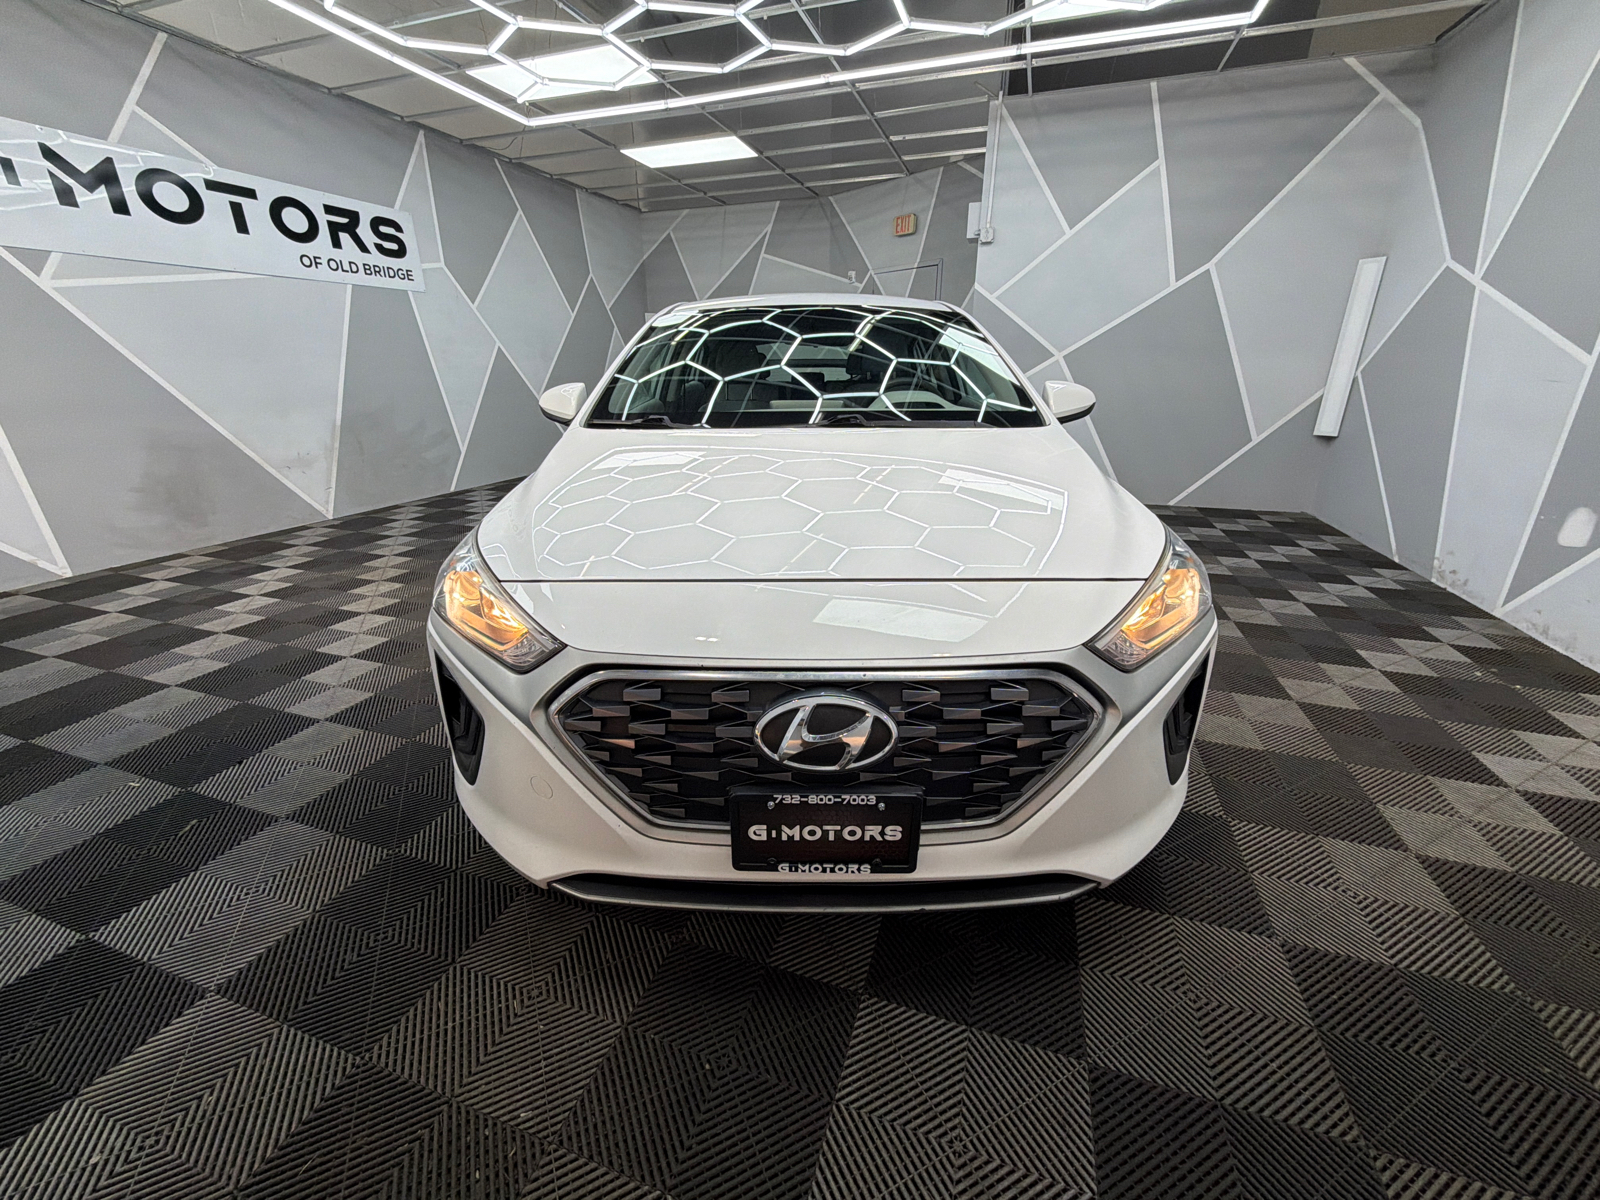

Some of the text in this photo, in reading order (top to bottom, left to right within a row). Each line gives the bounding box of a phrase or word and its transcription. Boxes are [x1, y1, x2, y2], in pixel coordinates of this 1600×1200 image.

[895, 214, 912, 234] EXIT
[300, 254, 415, 282] OF OLD BRIDGE
[773, 794, 877, 805] 732-800-7003
